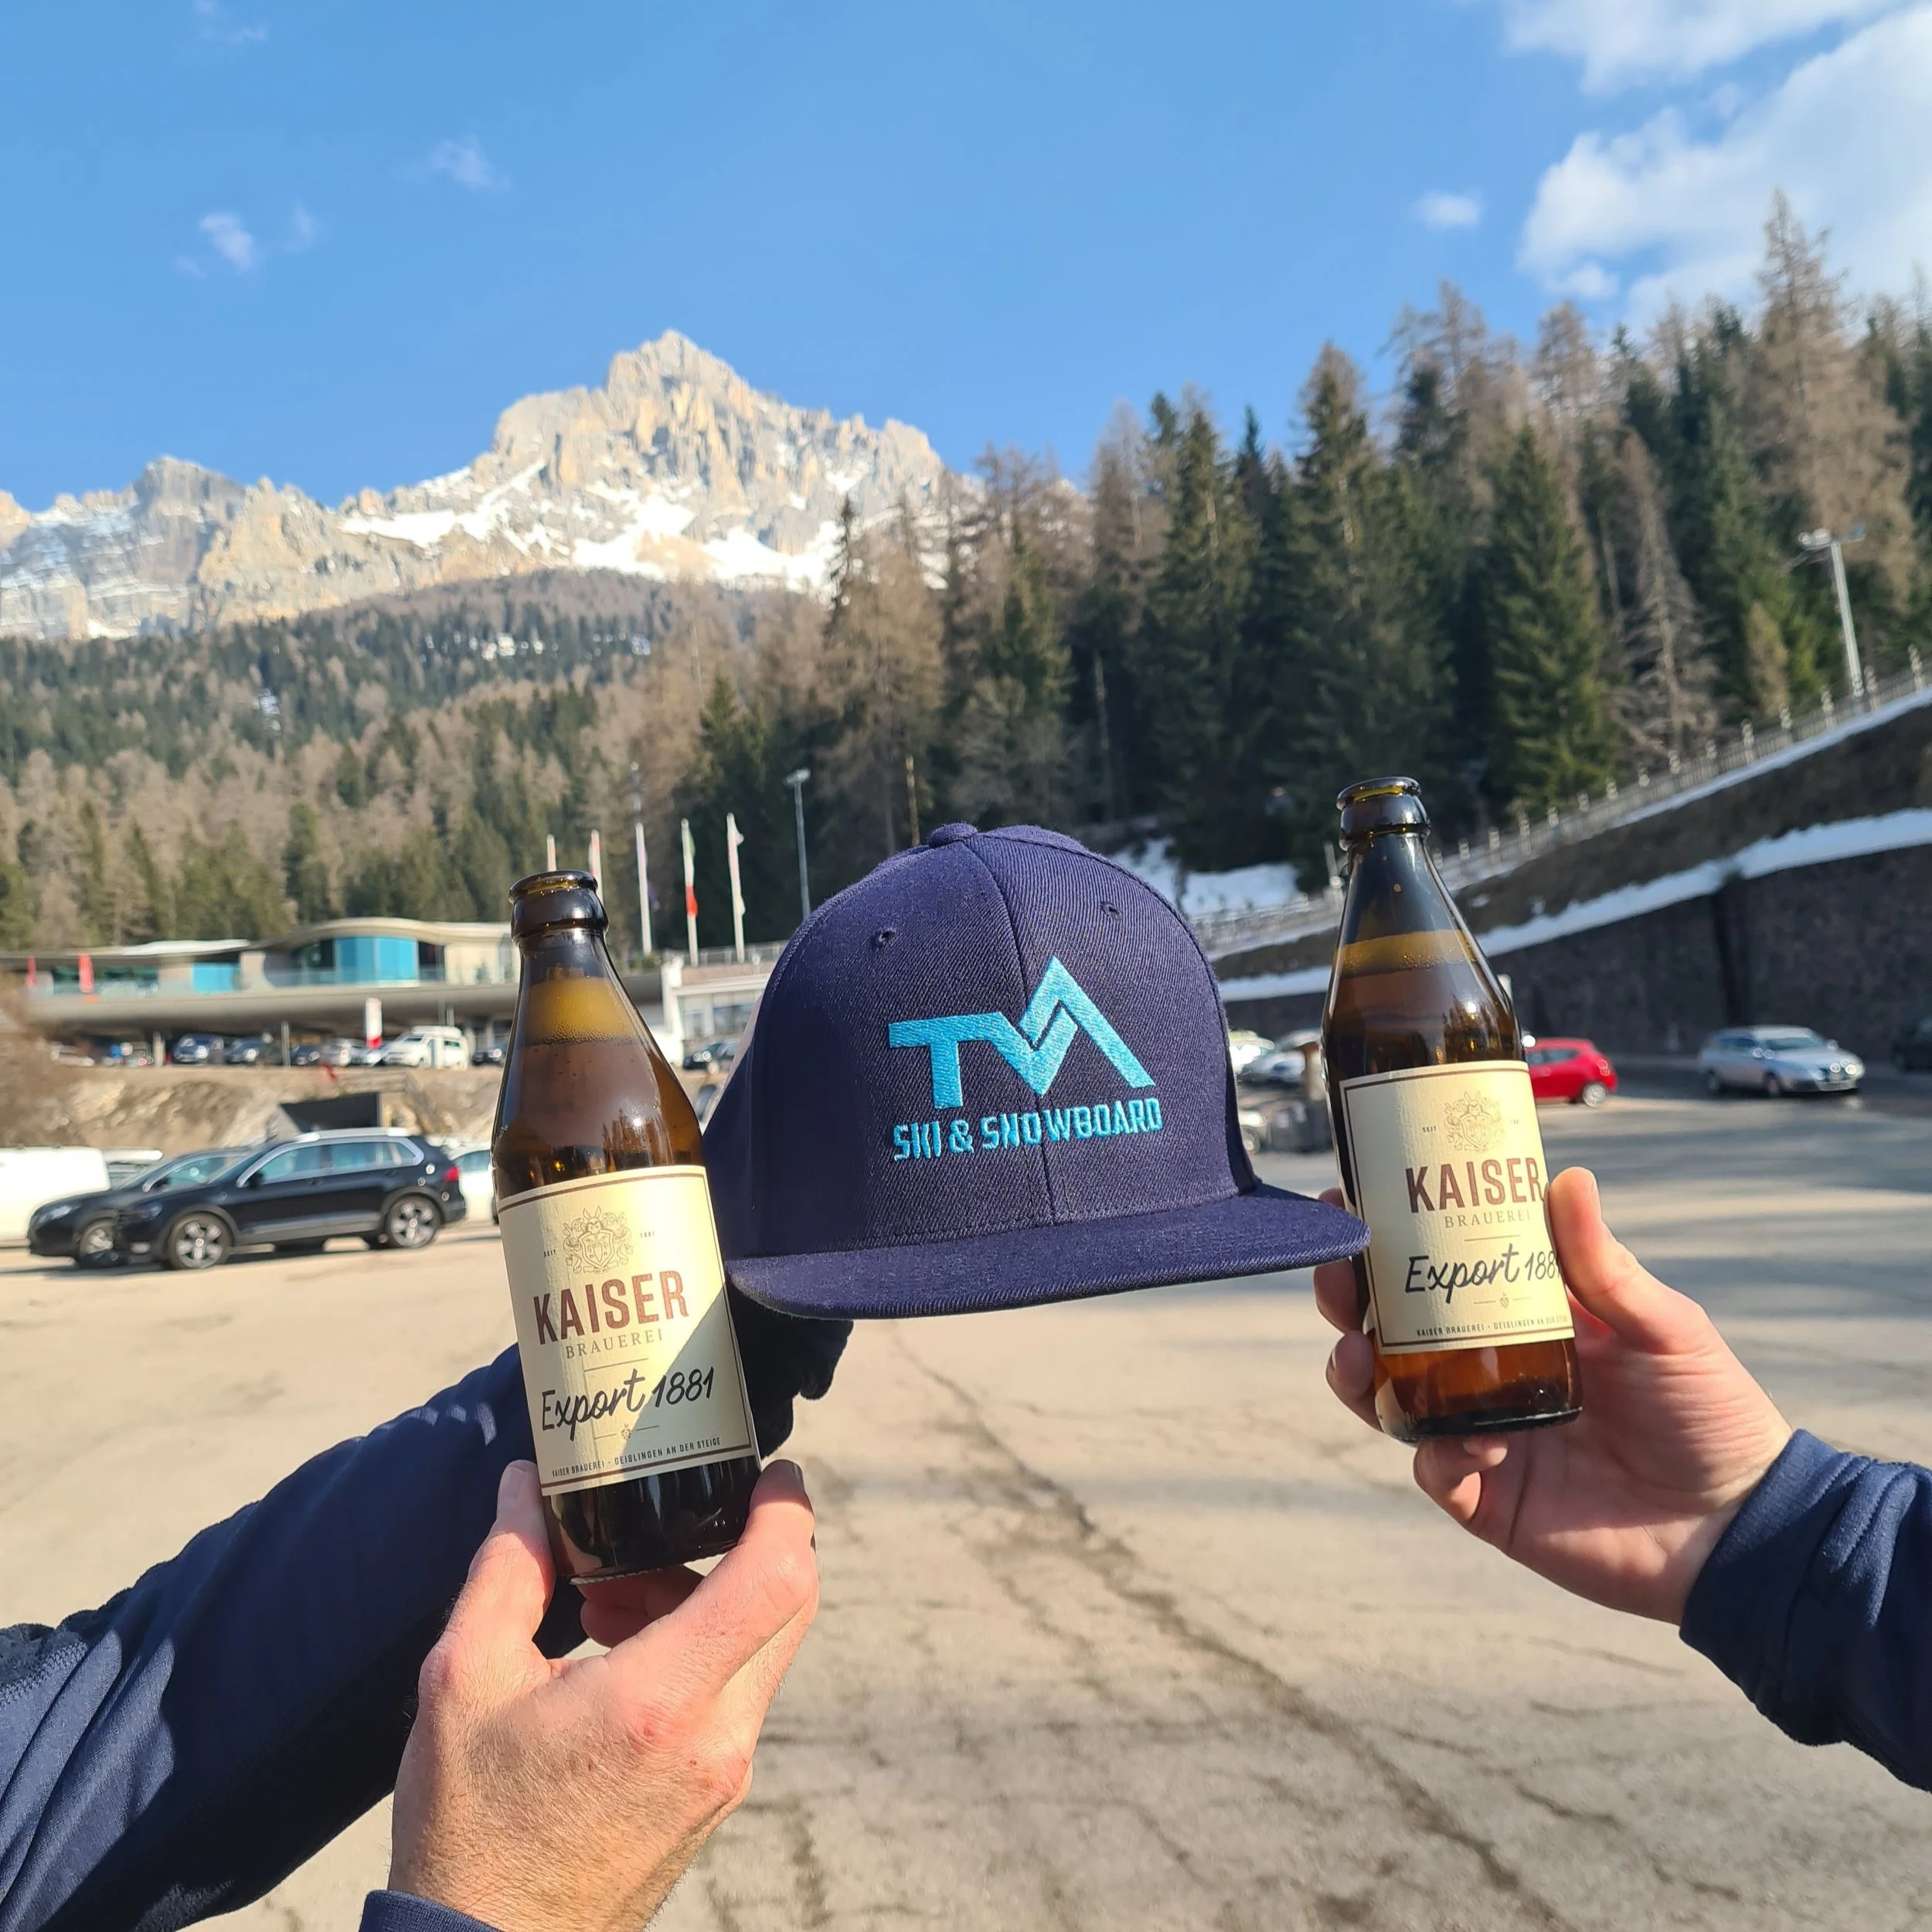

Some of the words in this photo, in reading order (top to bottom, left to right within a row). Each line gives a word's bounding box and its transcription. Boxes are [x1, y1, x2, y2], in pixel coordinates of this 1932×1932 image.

[893, 1120, 941, 1162] SKI
[948, 1119, 975, 1155] &
[980, 1097, 1163, 1151] SNOWBOARD
[1405, 1157, 1545, 1214] KAISER
[1444, 1209, 1531, 1228] BRAUEREI
[1404, 1243, 1521, 1304] Export
[1524, 1250, 1560, 1281] 188
[533, 1270, 689, 1345] KAISER
[1417, 1326, 1443, 1337] KAISER
[1446, 1323, 1485, 1335] BRAUEREI
[565, 1328, 663, 1359] BRAUEREI
[542, 1368, 645, 1441] Export
[651, 1366, 715, 1408] 1881
[552, 1467, 570, 1478] KAISER
[571, 1461, 605, 1475] BRAUEREI
[614, 1448, 663, 1465] GEISLINGEN
[666, 1446, 677, 1455] AN
[679, 1442, 695, 1453] DER
[697, 1437, 721, 1450] STEIGE
